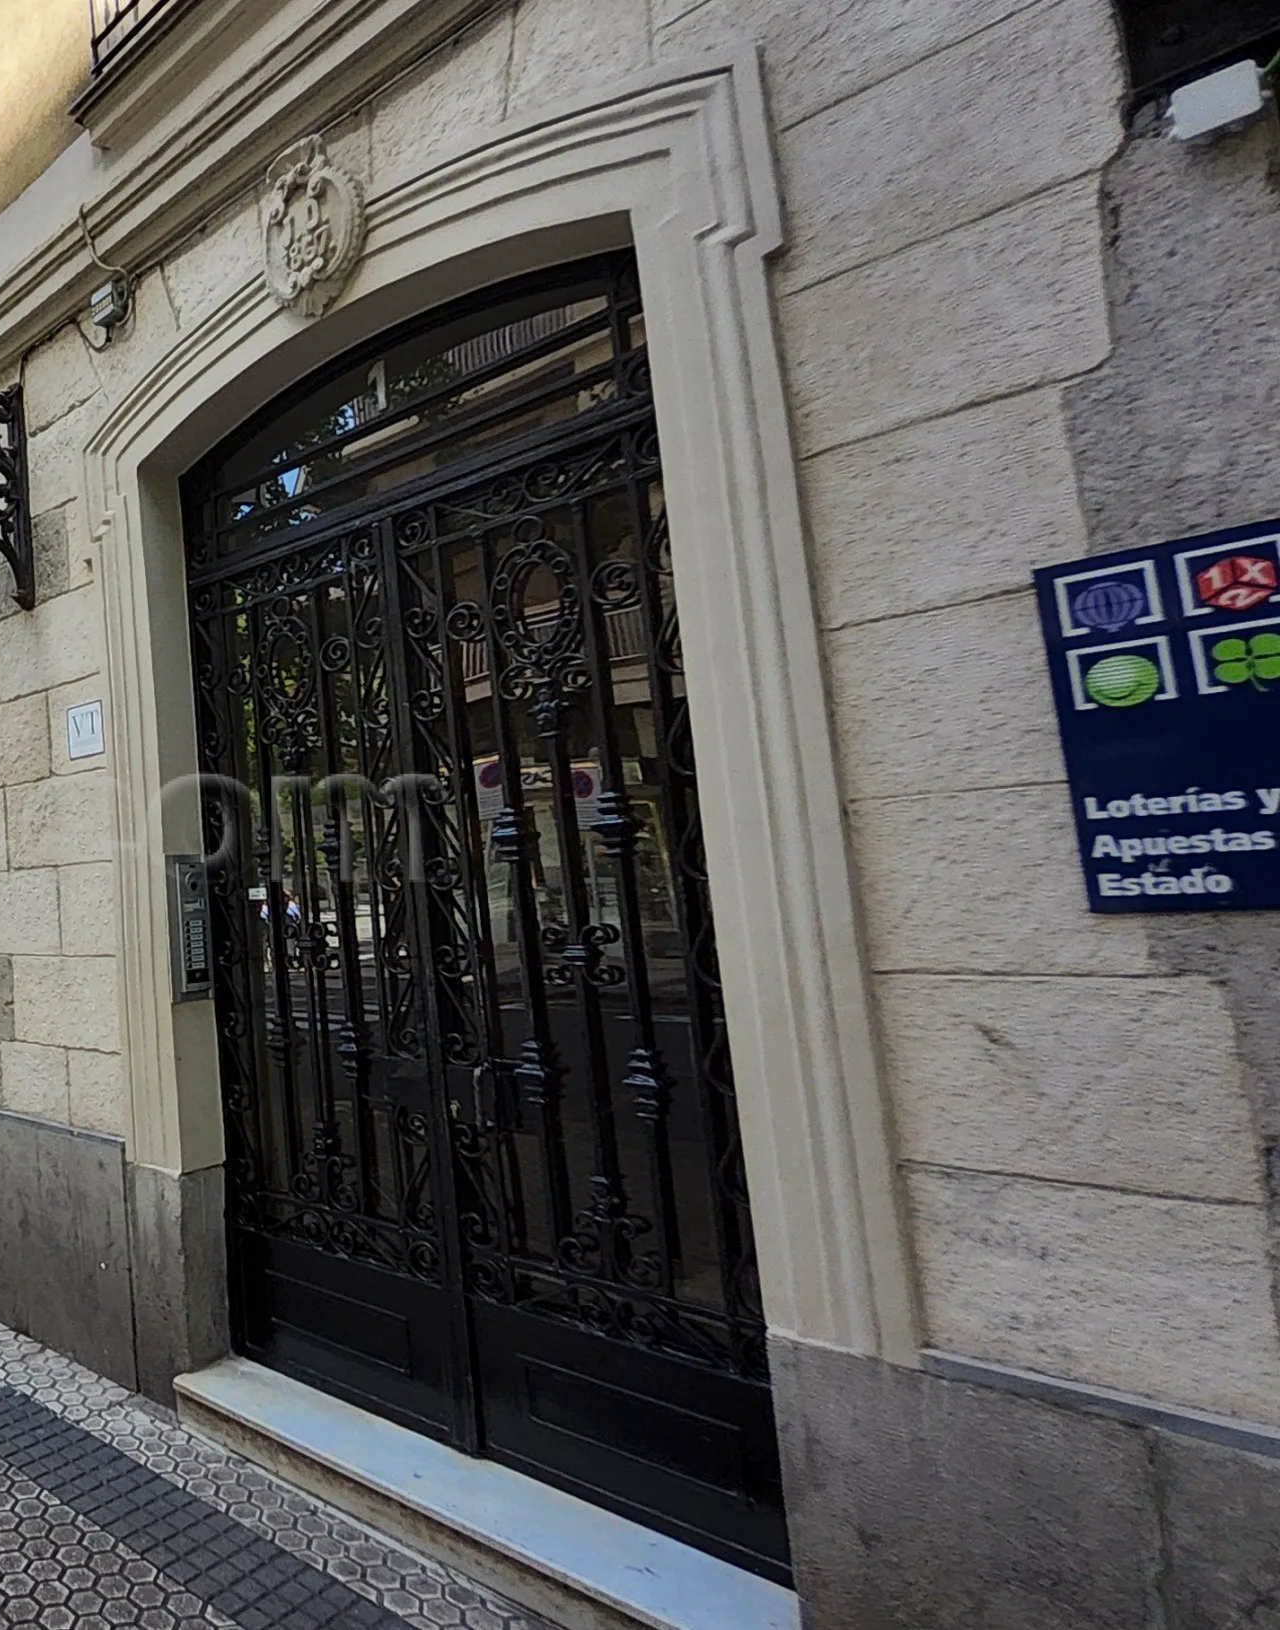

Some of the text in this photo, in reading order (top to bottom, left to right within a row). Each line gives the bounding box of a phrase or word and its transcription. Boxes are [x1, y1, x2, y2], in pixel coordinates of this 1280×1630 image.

[367, 360, 387, 410] 1
[72, 709, 100, 738] VT
[1084, 787, 1280, 820] Loterías y
[1091, 828, 1276, 863] Apuestas
[1097, 867, 1234, 897] Estado
